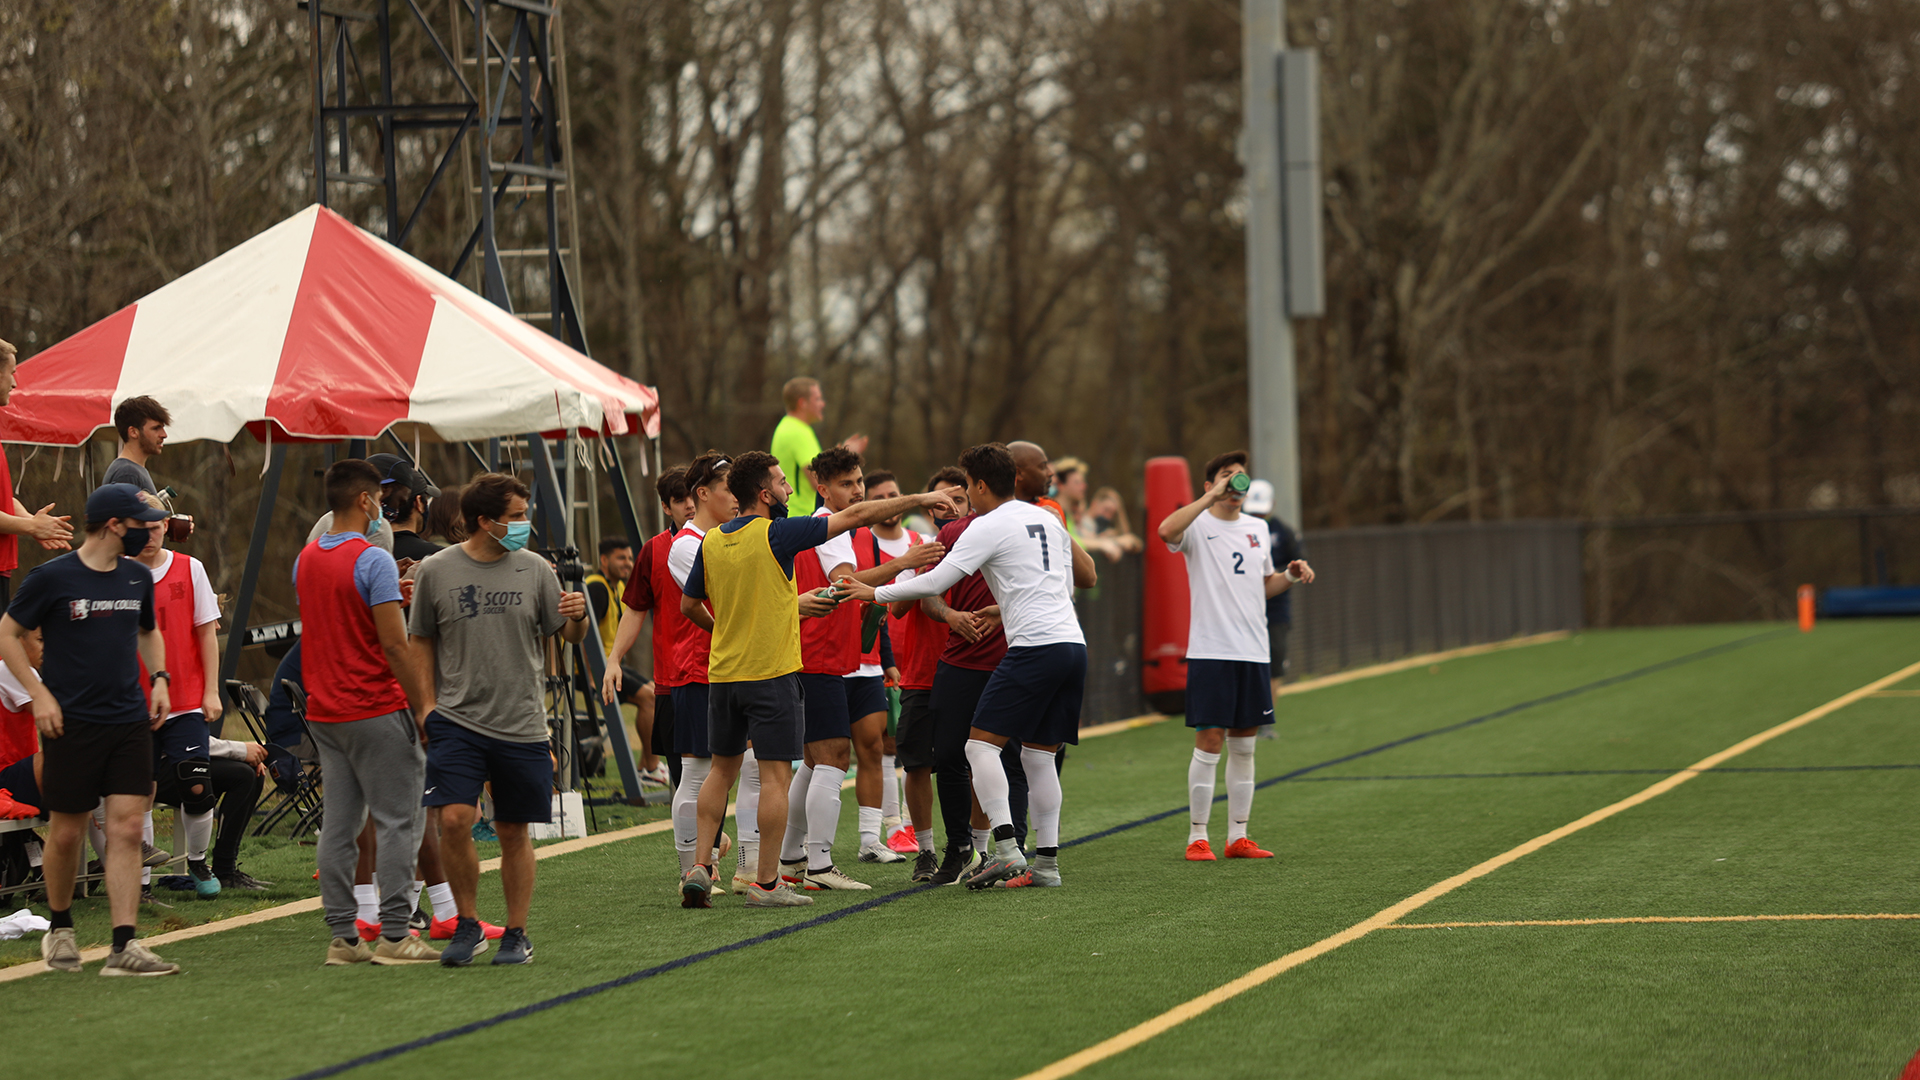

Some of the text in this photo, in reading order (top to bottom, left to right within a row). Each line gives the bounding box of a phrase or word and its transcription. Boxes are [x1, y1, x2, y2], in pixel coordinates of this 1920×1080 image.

[1025, 524, 1050, 571] 7
[1232, 552, 1245, 574] 2
[91, 599, 142, 611] LYON COLLEG
[484, 592, 523, 606] SCOTS
[158, 606, 167, 631] 1
[483, 606, 506, 615] SOCCER
